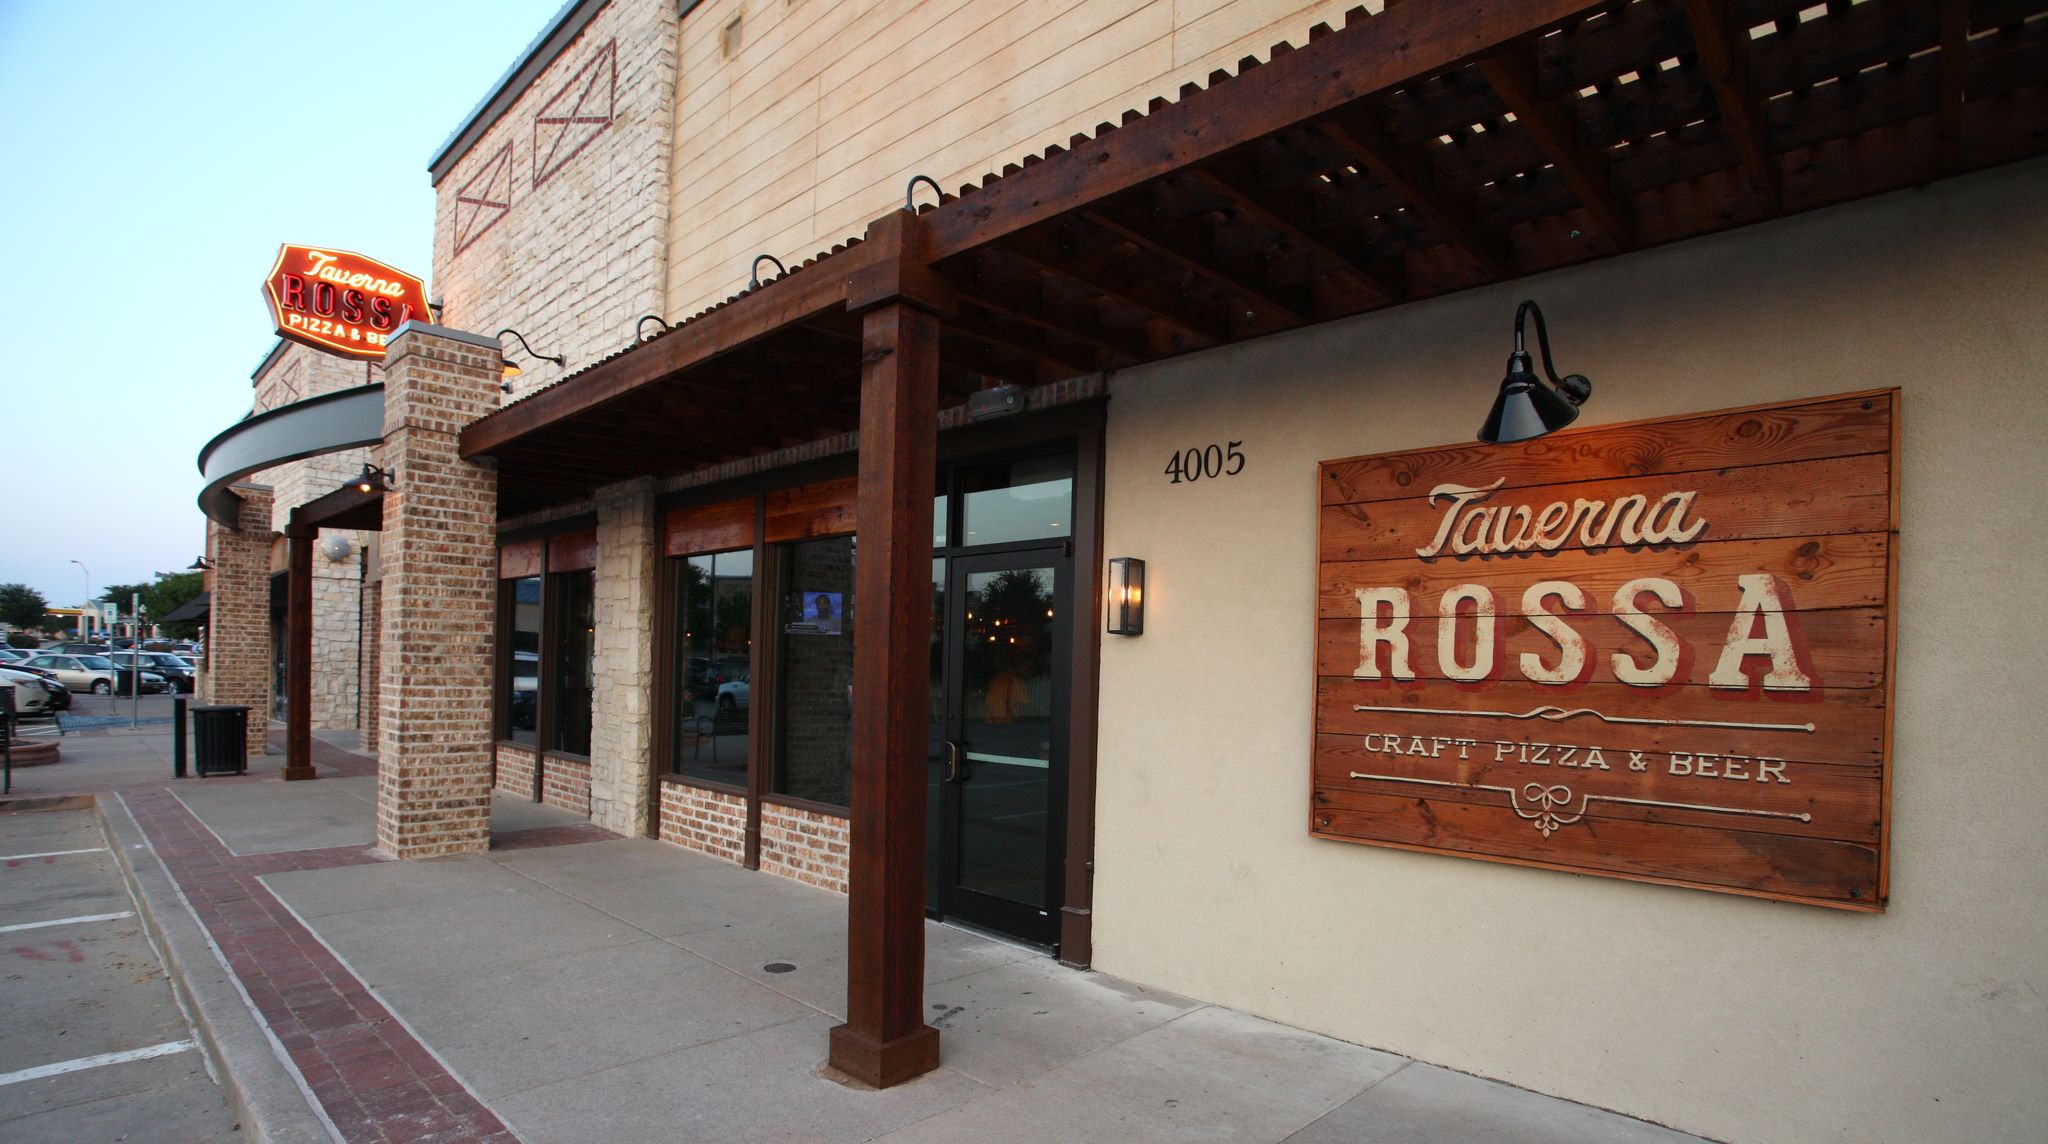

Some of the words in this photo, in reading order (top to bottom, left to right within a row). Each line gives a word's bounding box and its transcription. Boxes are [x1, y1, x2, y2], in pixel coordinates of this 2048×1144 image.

[303, 251, 405, 297] Taverna
[289, 313, 345, 338] PIZZA
[350, 328, 360, 340] &
[366, 331, 388, 346] BE
[1164, 440, 1246, 484] 4005
[1416, 476, 1707, 558] Taverna
[1353, 573, 1811, 692] ROSSA
[1363, 732, 1477, 760] CRAFT
[1494, 739, 1610, 771] PIZZA
[1628, 750, 1648, 773] &
[1668, 751, 1792, 784] BEER
